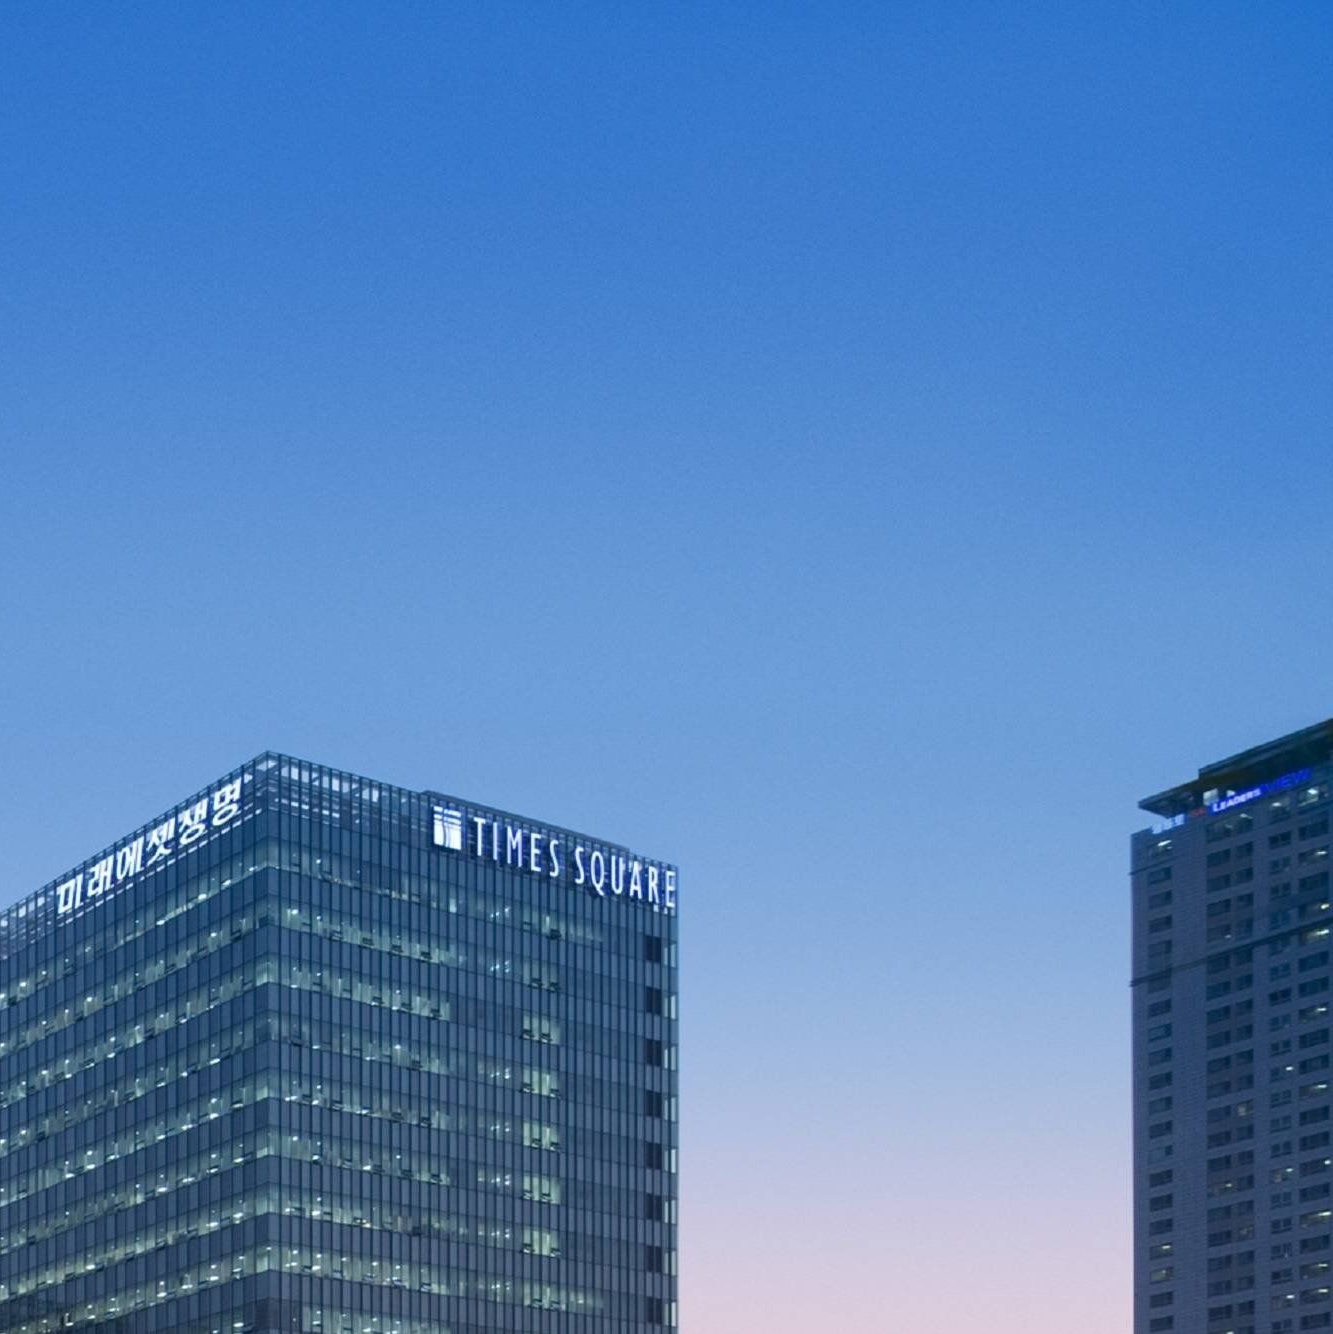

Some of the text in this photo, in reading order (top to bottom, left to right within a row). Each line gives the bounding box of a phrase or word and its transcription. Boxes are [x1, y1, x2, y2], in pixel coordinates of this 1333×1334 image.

[56, 777, 242, 915] 미래에셋생명
[473, 816, 677, 908] TIMES SQUARE
